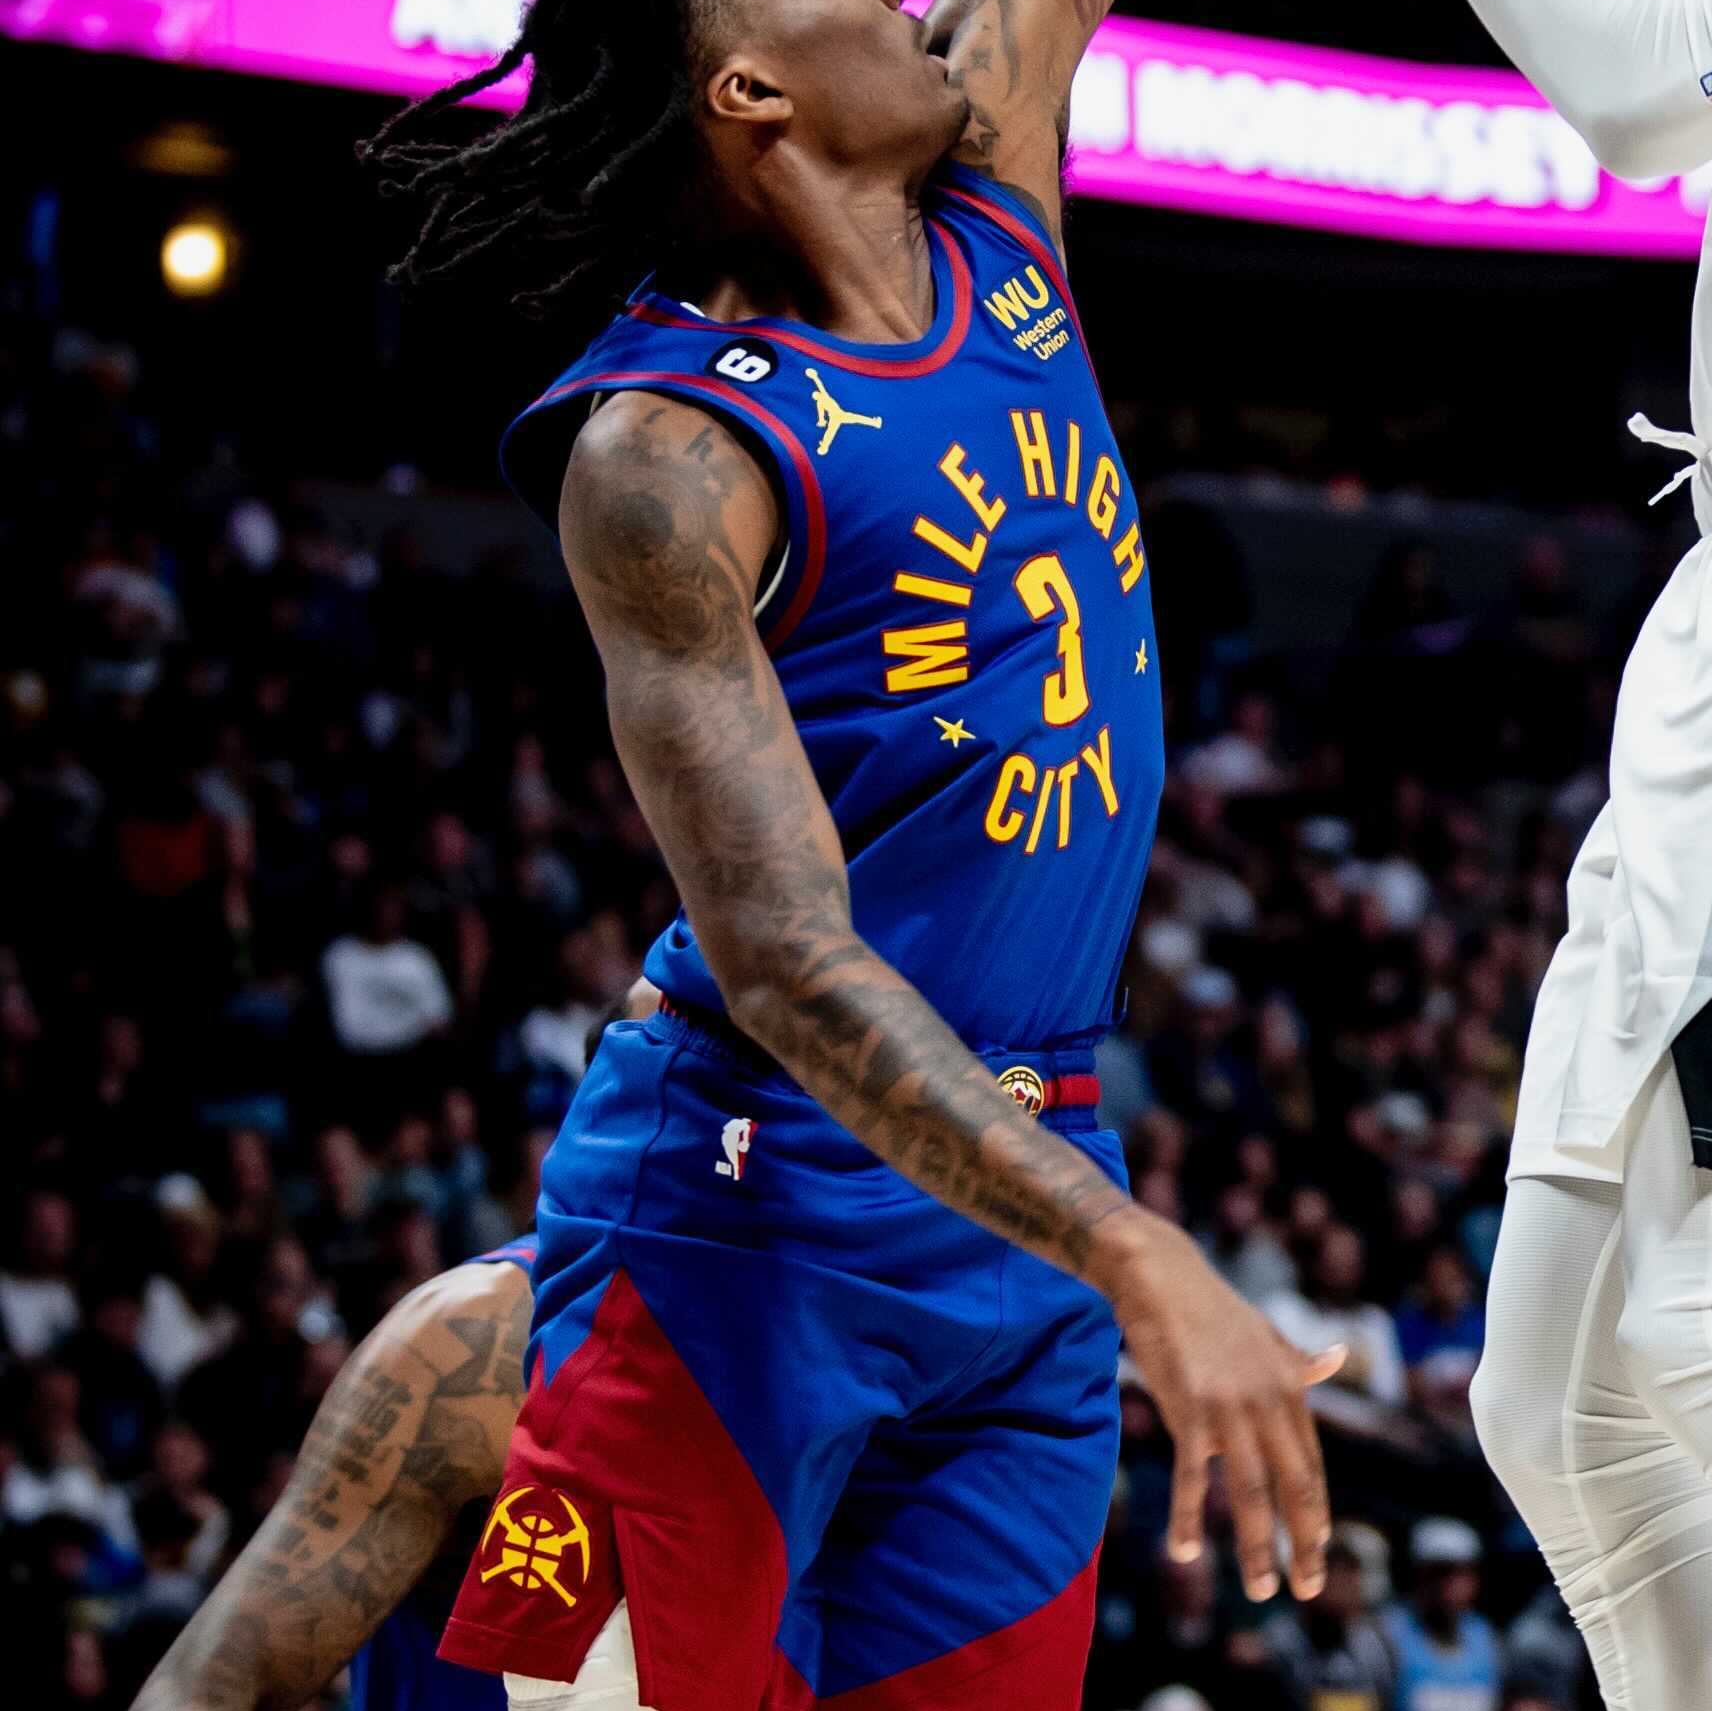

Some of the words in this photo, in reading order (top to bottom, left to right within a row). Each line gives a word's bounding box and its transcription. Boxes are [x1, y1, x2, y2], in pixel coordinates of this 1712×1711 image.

[983, 264, 1050, 330] WU
[1012, 308, 1067, 351] Western
[715, 347, 771, 383] 6
[1034, 329, 1070, 360] Union
[881, 441, 1006, 693] MILE
[1008, 407, 1147, 594] HIGH
[1013, 551, 1090, 729] 3
[982, 724, 1120, 855] CITY
